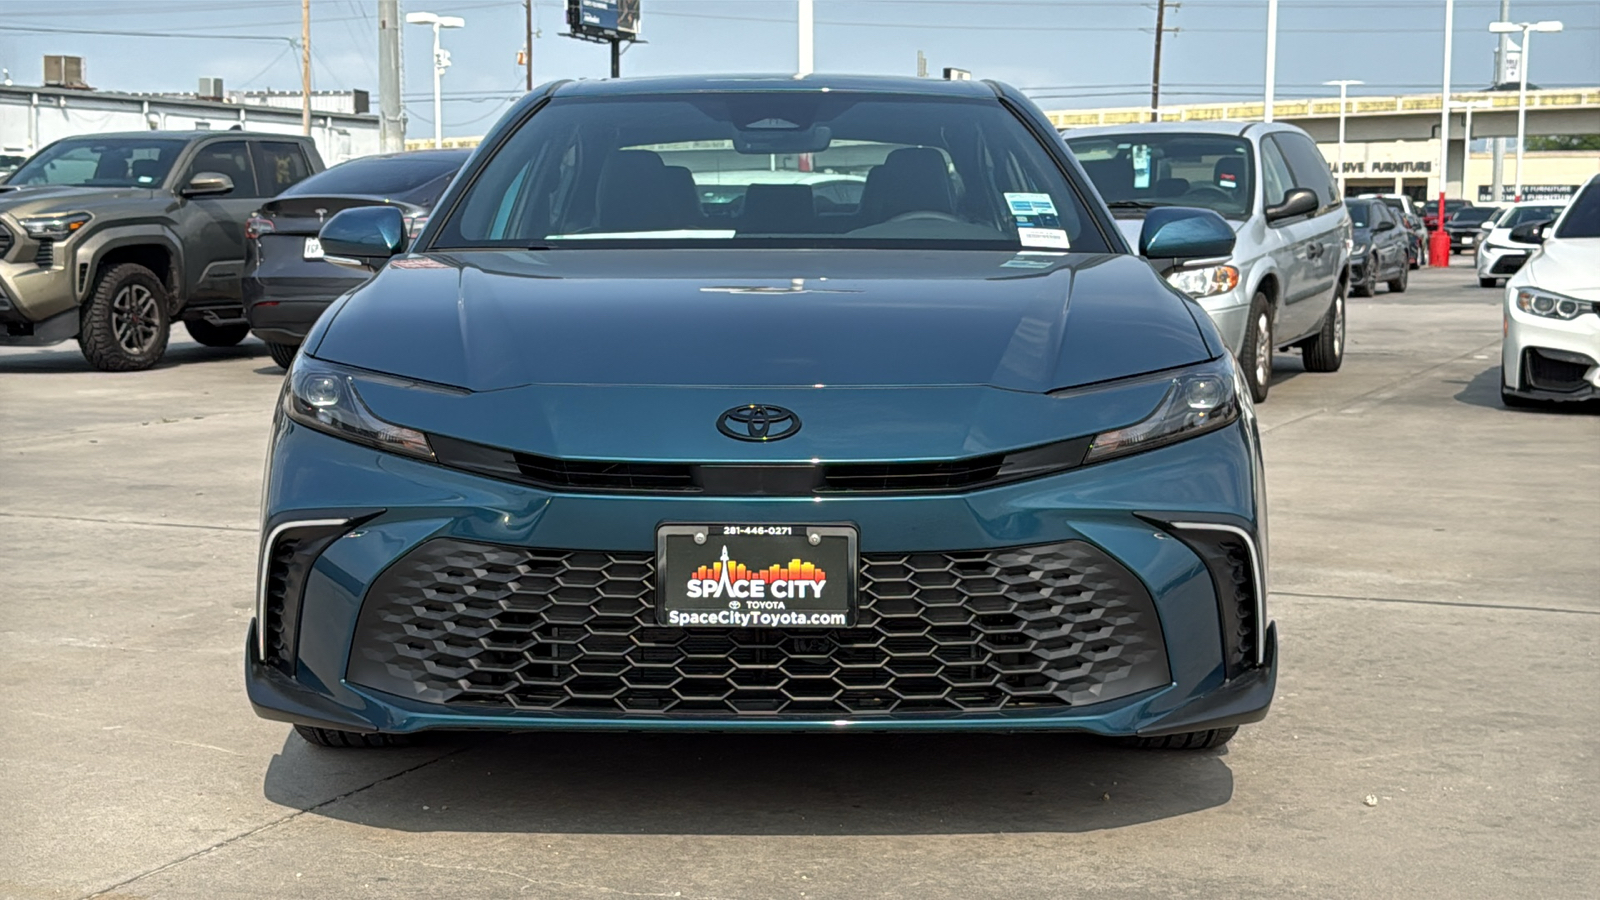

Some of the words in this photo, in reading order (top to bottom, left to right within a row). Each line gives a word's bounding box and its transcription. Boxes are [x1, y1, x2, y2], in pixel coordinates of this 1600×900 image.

[1371, 161, 1432, 172] FURNITURE
[723, 526, 792, 535] 281-446-0271
[686, 578, 765, 598] SPACE
[770, 579, 827, 598] CITY
[746, 600, 785, 609] TOYOTA
[669, 610, 846, 627] SpaceCityToyota.com
